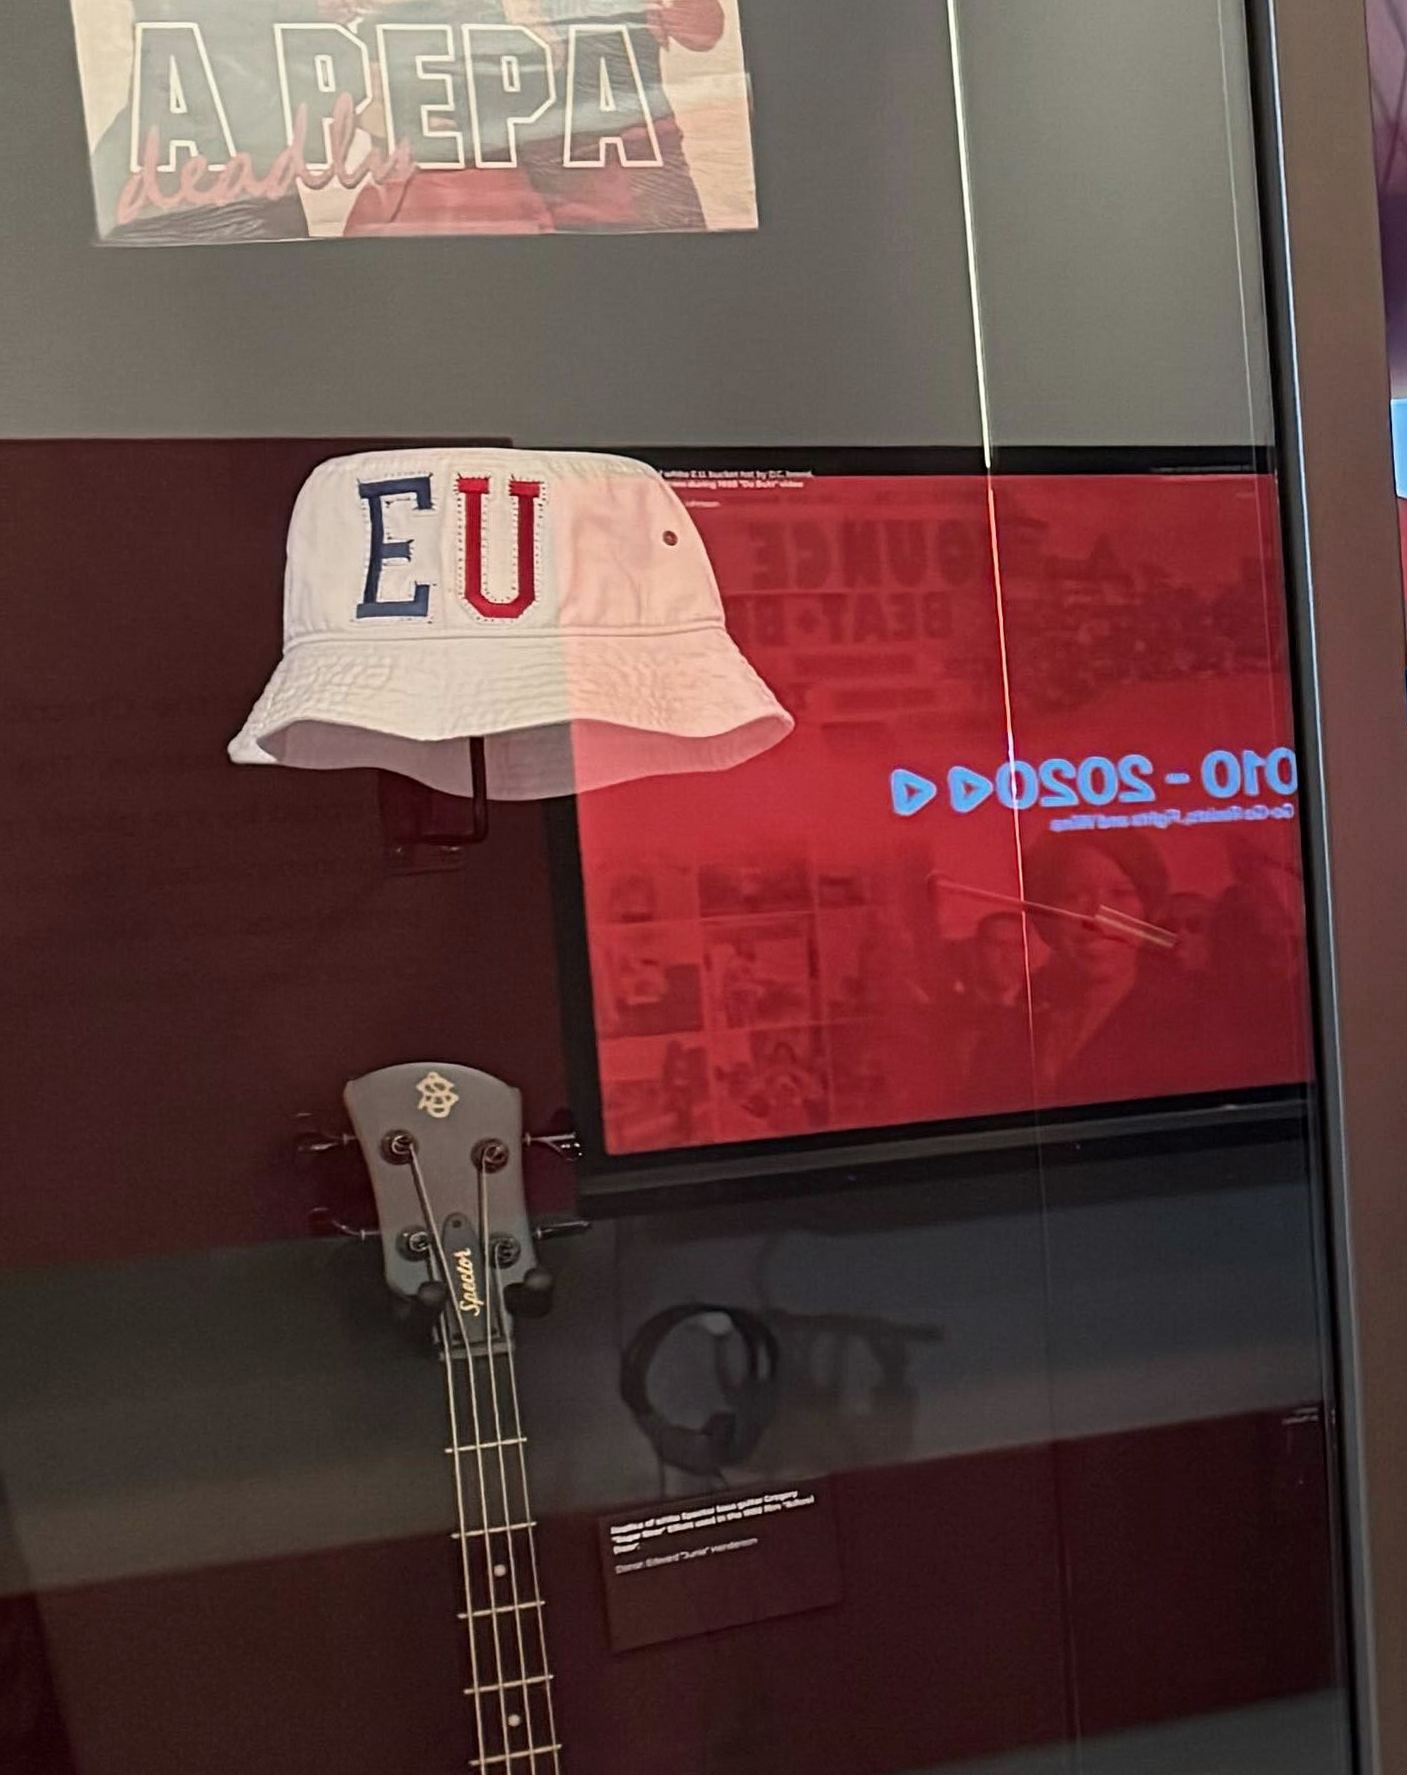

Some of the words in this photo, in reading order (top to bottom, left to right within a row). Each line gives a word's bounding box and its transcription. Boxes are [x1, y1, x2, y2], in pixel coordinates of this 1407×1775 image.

[130, 21, 239, 172] A
[274, 21, 662, 170] PEPA
[355, 474, 545, 622] EU
[458, 1247, 481, 1317] Spector
